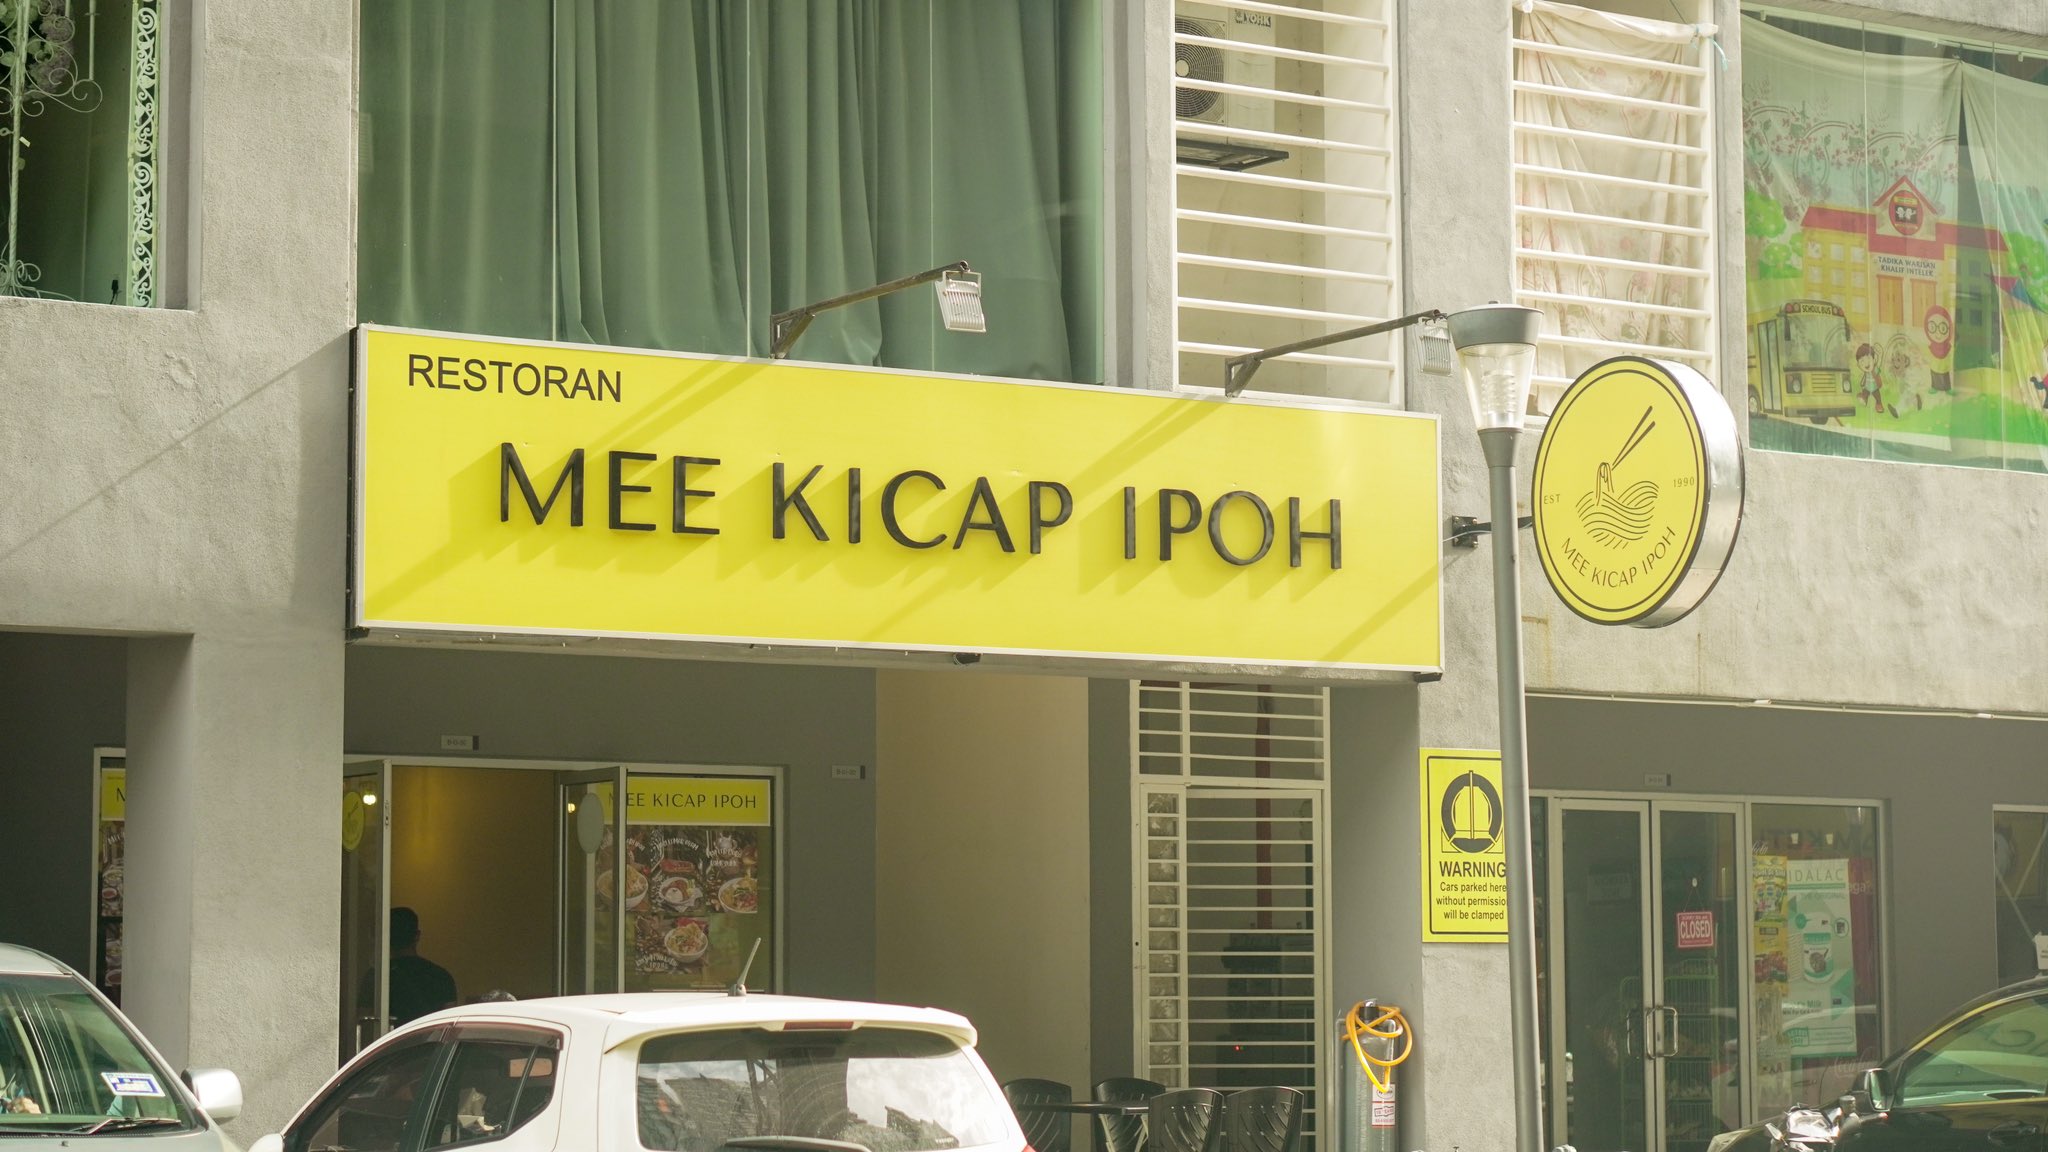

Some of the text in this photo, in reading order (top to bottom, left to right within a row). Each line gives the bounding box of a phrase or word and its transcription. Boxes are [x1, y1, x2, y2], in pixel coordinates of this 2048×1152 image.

[1877, 255, 1936, 270] TADIKA WARISAN
[1801, 304, 1831, 316] SCHOOL BUS
[408, 353, 622, 404] RESTORAN
[1672, 476, 1696, 488] 1990
[500, 442, 1342, 570] MEE KICAP IPOH
[1543, 493, 1561, 505] EST
[1561, 525, 1677, 588] MEE KICAP IPOH
[652, 792, 707, 809] KICAP
[713, 793, 757, 809] IPOH
[1438, 860, 1507, 878] WARNING
[1439, 881, 1507, 893] Cars parked here
[1435, 895, 1508, 908] without permissio
[1443, 909, 1505, 922] will be clamped
[1679, 919, 1711, 940] CLOSED
